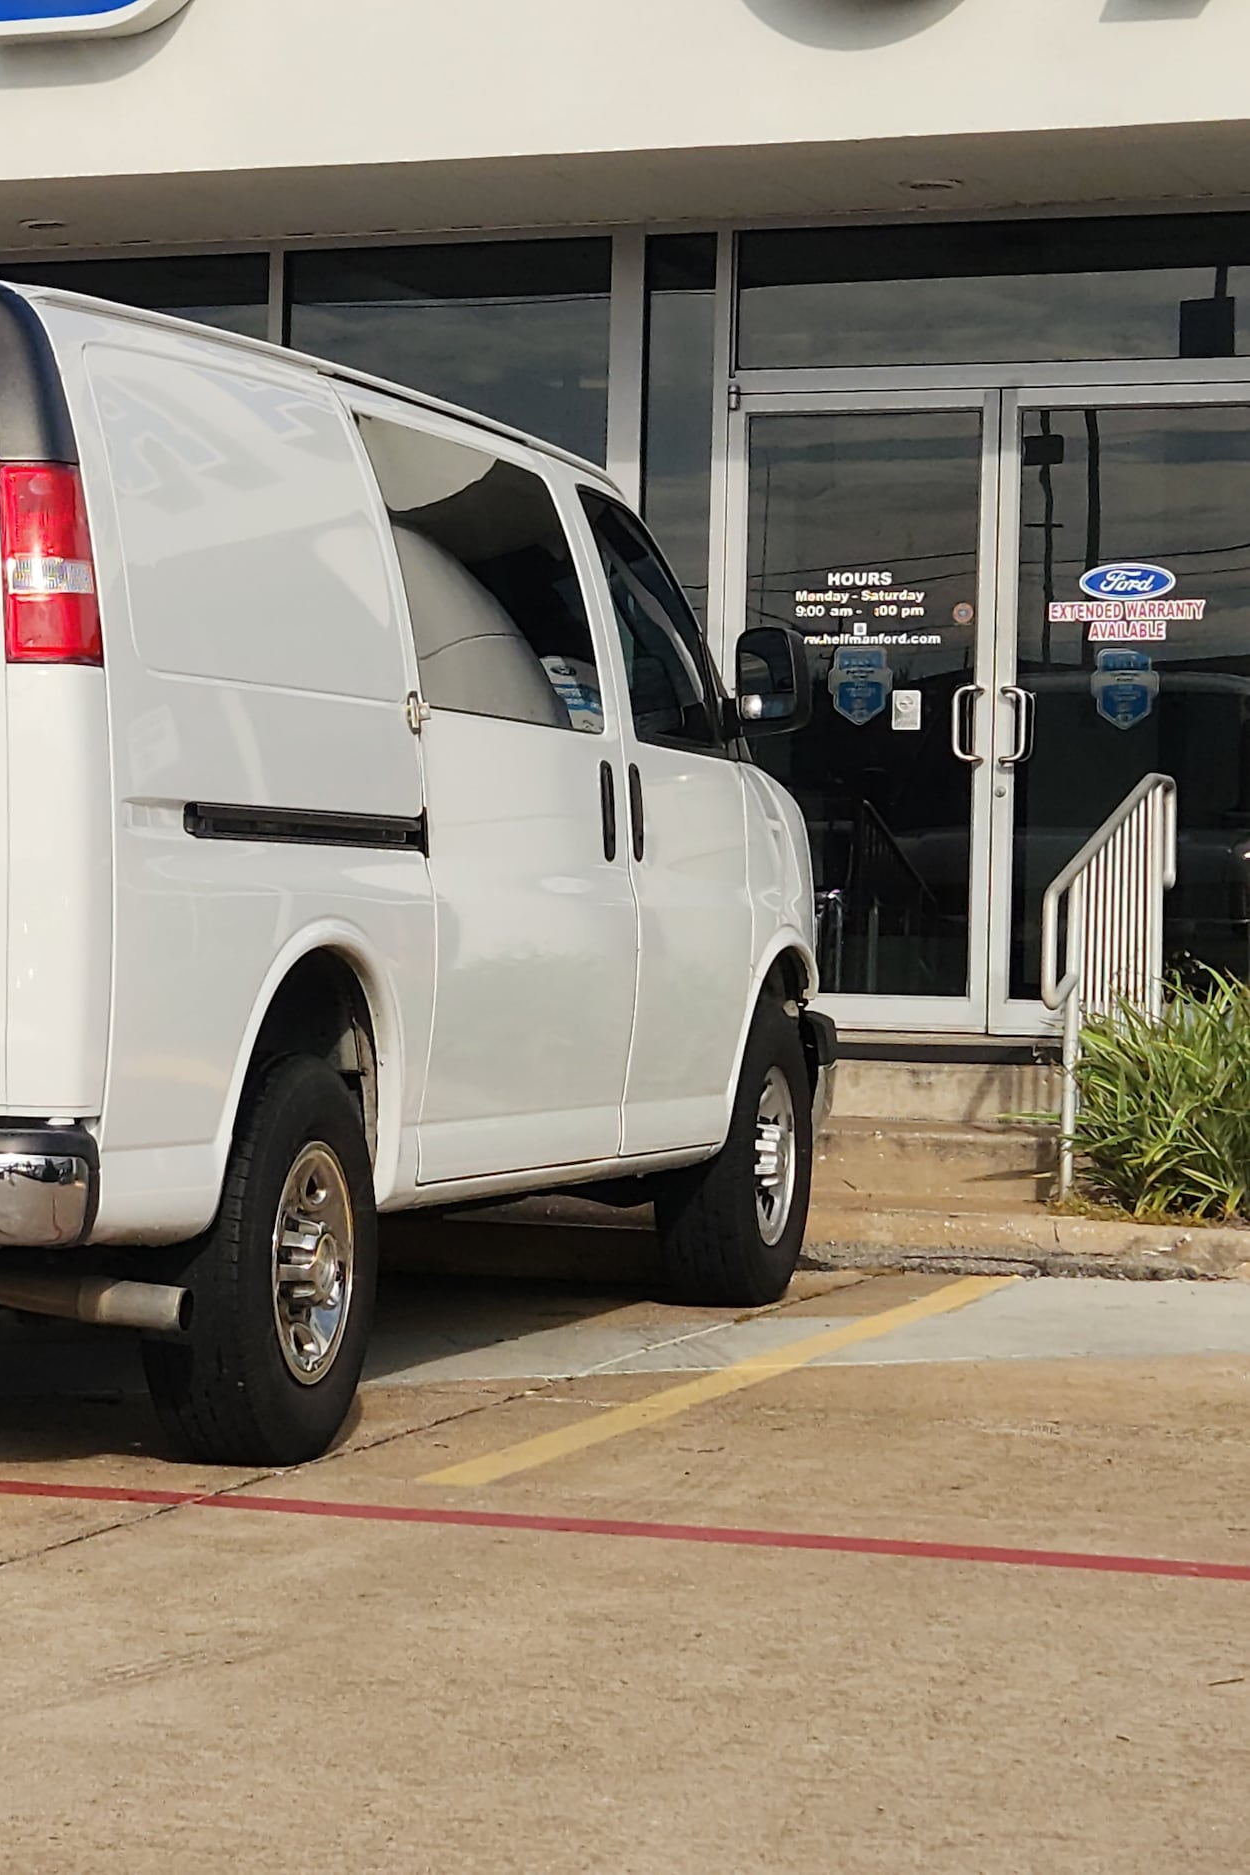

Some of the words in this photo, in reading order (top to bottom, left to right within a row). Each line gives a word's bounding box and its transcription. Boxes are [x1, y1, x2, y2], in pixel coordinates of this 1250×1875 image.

[827, 572, 893, 586] HOURS
[1100, 569, 1156, 592] Ford
[795, 590, 850, 603] Monday
[860, 589, 925, 603] Saturday
[795, 605, 825, 617] 9:00
[829, 608, 853, 617] am
[901, 608, 925, 618] pm
[1049, 601, 1122, 621] EXTENDED
[1124, 600, 1206, 621] WARRANTY
[1088, 621, 1166, 641] AVAILABLE
